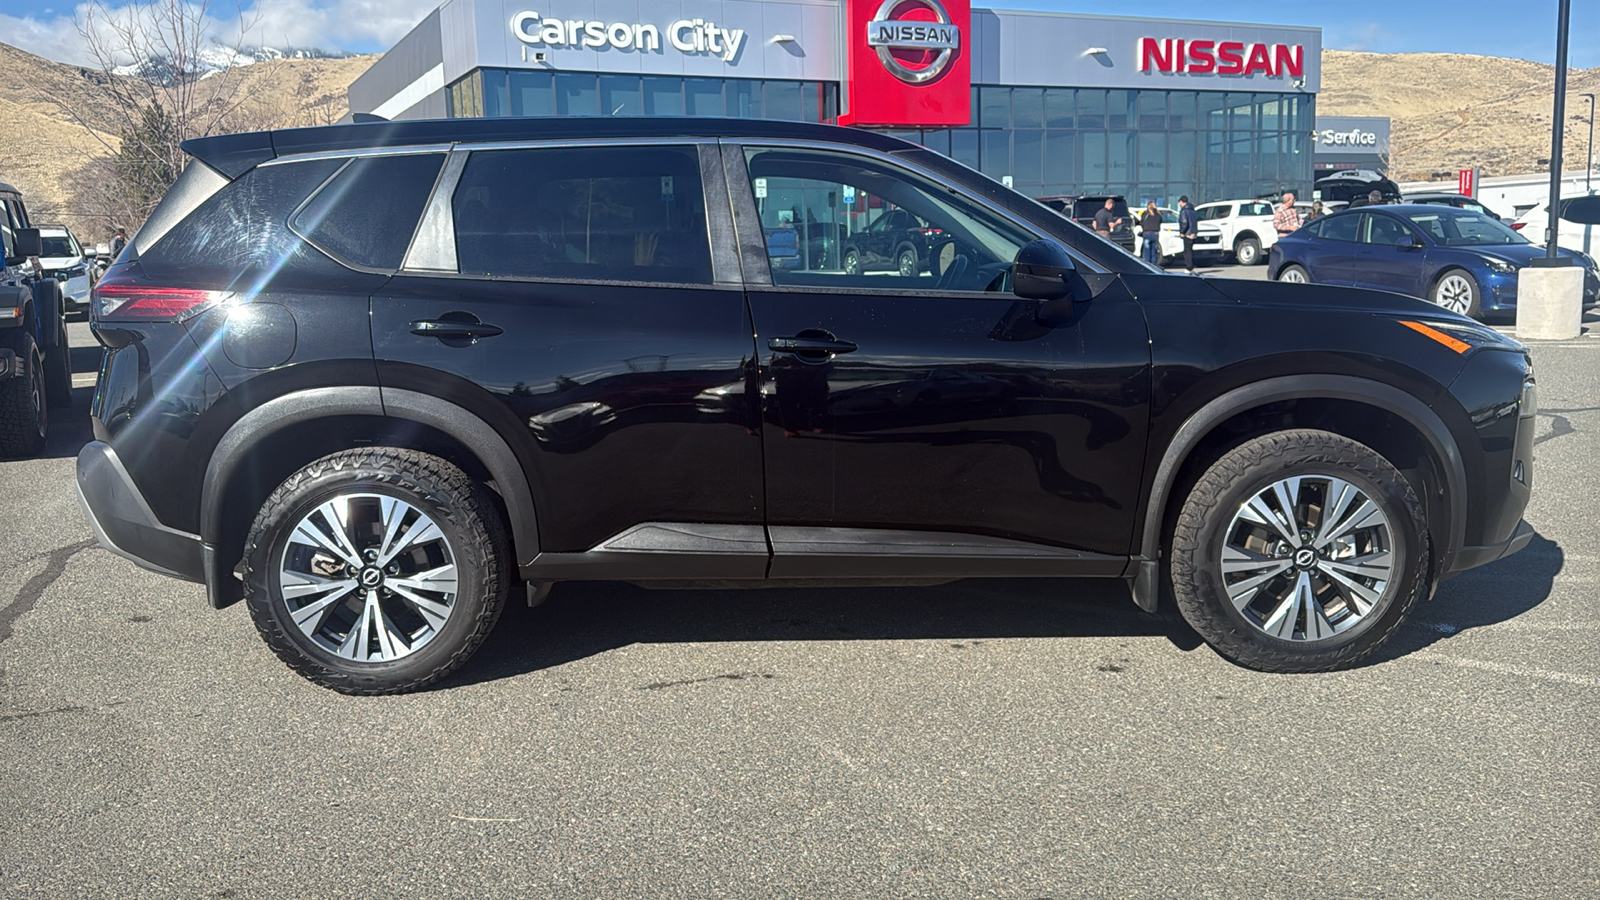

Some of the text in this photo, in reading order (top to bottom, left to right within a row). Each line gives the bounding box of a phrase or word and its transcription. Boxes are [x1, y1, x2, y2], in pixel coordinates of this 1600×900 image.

[512, 10, 744, 62] Carson City
[879, 25, 953, 45] NISSAN
[1139, 37, 1304, 77] NISSAN
[1325, 128, 1376, 145] Service
